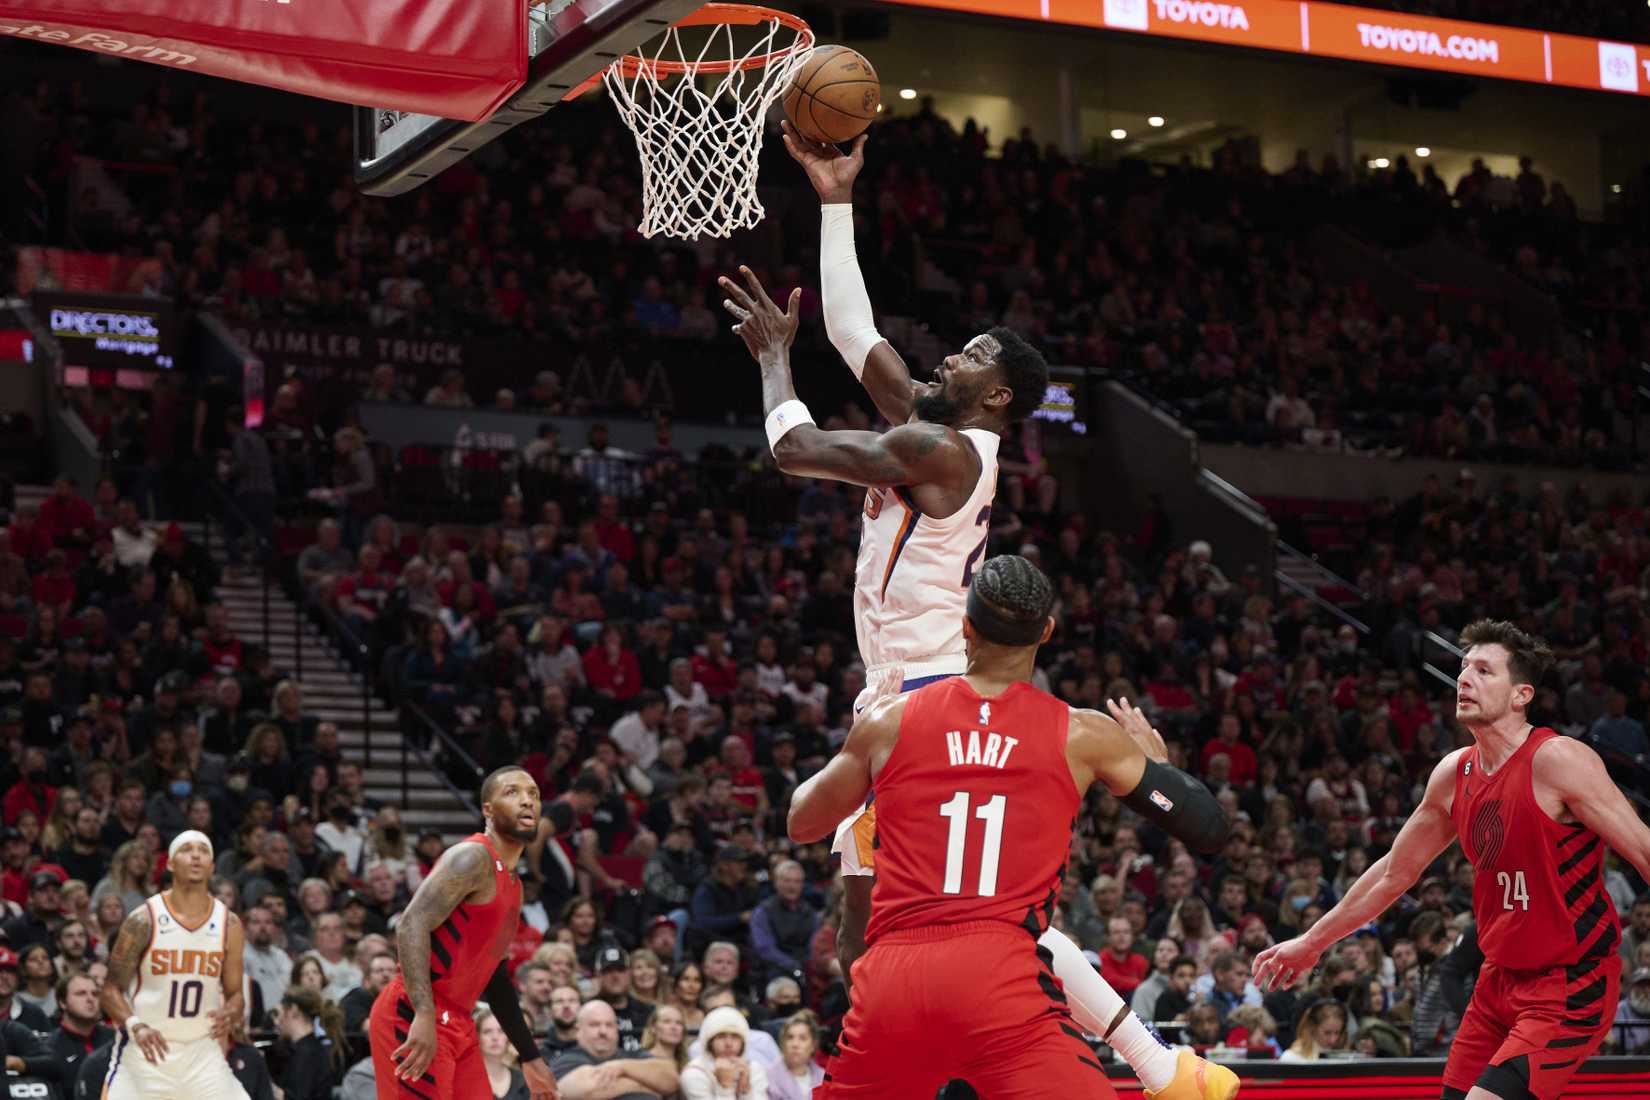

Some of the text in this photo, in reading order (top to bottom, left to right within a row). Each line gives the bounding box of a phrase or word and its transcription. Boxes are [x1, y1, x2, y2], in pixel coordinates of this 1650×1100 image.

[1152, 0, 1249, 31] TOYOTA
[1357, 23, 1499, 63] TOYOTA.COM
[376, 337, 464, 365] TRUCK
[946, 730, 1019, 769] HART
[939, 791, 1007, 897] 11
[1496, 870, 1530, 912] 24
[168, 980, 204, 1019] 10
